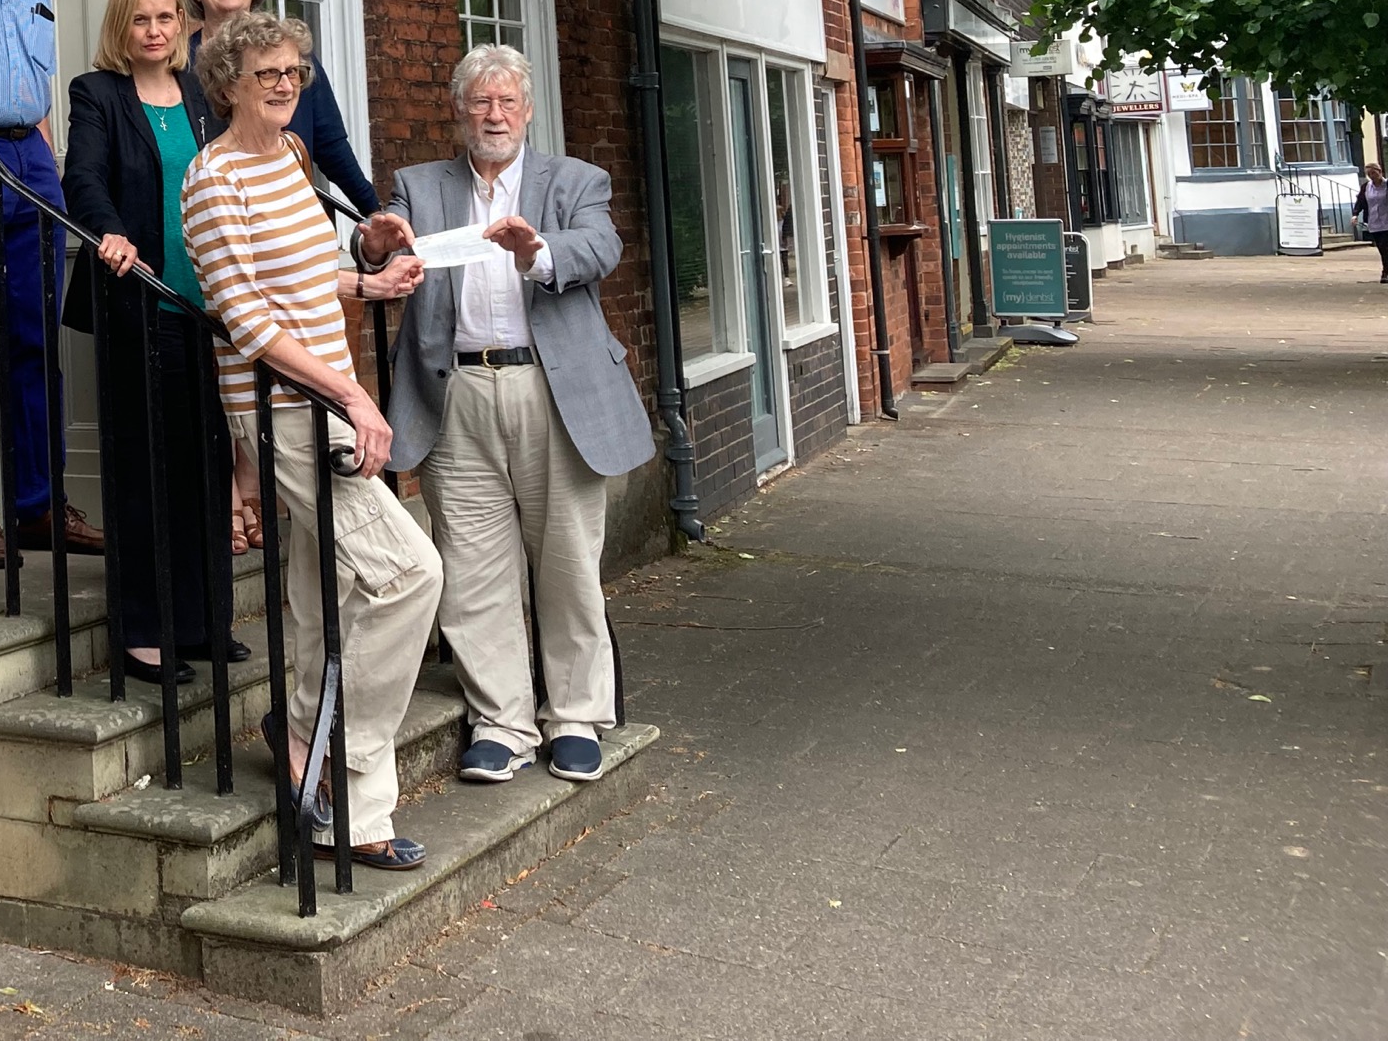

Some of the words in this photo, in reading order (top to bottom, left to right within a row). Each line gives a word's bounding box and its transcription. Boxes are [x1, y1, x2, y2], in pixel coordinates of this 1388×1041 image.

[1112, 103, 1159, 113] JEWELLERS
[1005, 232, 1046, 242] Hygienist
[996, 242, 1056, 251] appointments
[1006, 251, 1047, 259] available
